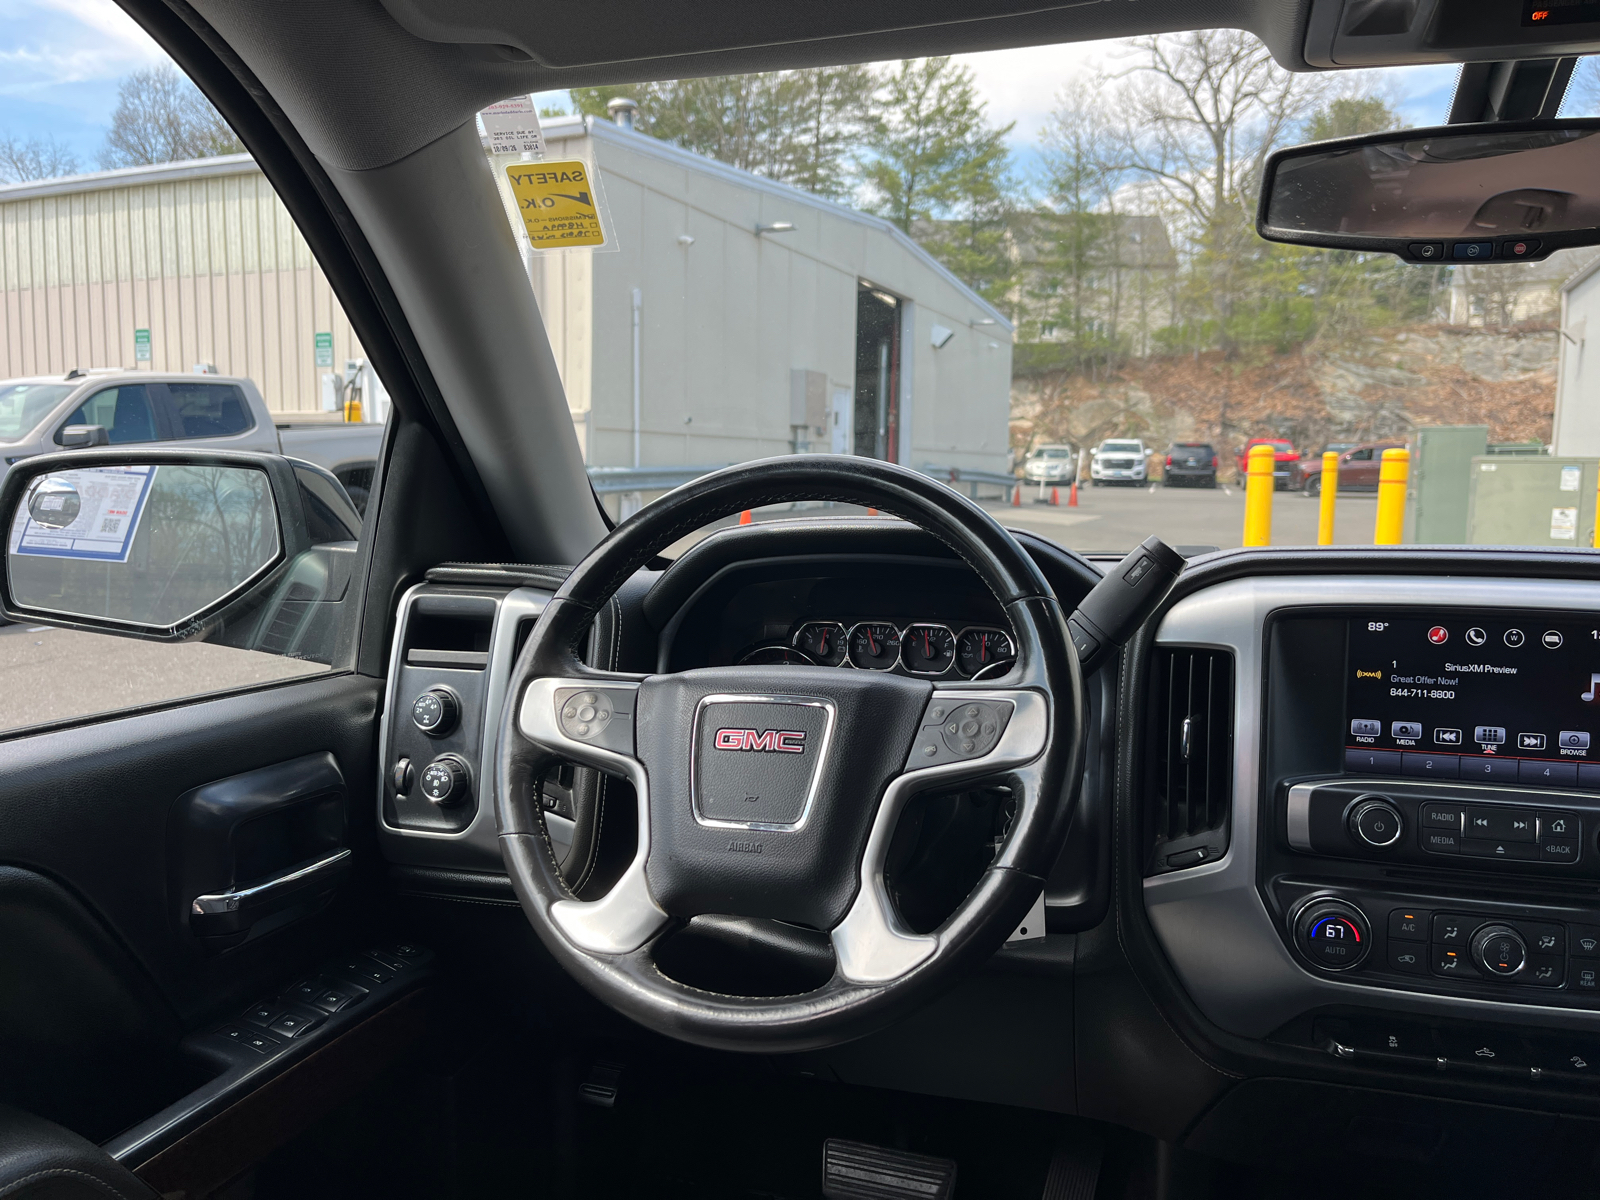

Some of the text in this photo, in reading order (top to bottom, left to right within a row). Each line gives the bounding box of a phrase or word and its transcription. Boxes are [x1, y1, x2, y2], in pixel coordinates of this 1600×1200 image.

[1532, 11, 1549, 20] OFF
[1392, 660, 1397, 669] 1
[1445, 663, 1518, 674] SiriusXM Preview
[1390, 675, 1459, 686] Great Offer Now!
[1390, 688, 1455, 699] 844-711-8800
[714, 727, 807, 754] GMC
[1560, 748, 1587, 756] BROWSE
[1425, 760, 1433, 769] 2
[1484, 765, 1491, 773] 3
[1543, 768, 1550, 776] 4
[1431, 812, 1455, 822] RADIO
[1430, 835, 1455, 845] MEDIA
[727, 841, 764, 854] AIRBAG
[1550, 845, 1571, 855] BACK
[1326, 924, 1344, 938] 67
[1401, 922, 1415, 932] A/C
[1324, 946, 1346, 955] AUTO
